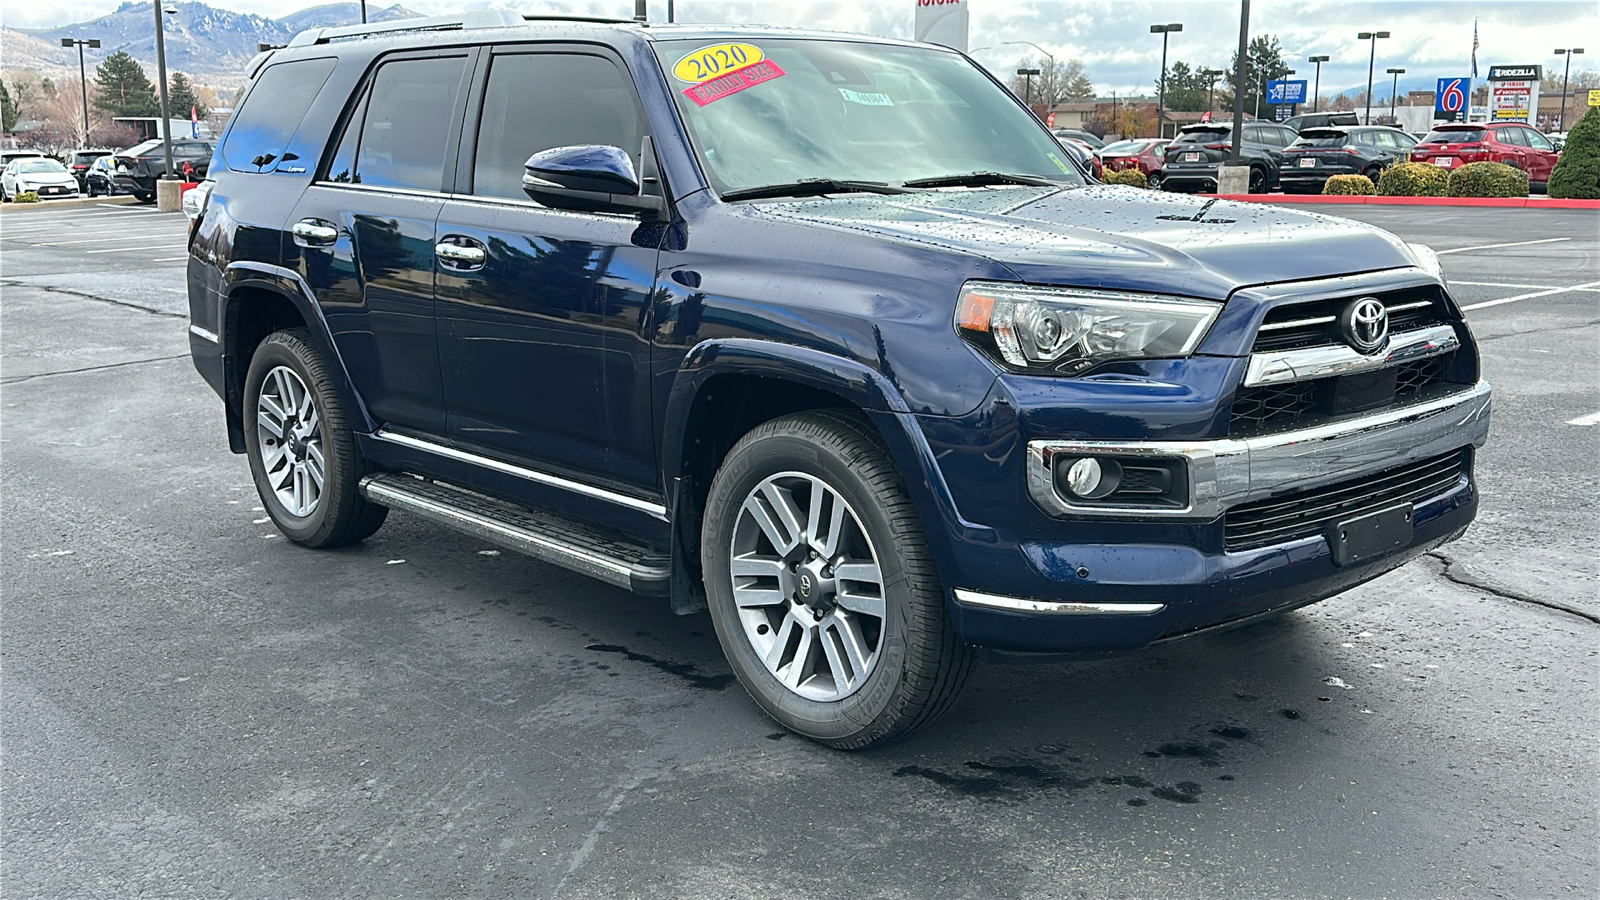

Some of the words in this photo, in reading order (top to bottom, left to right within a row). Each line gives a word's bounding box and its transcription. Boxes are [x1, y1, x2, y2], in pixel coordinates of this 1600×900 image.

[687, 45, 747, 79] 2020
[1501, 68, 1536, 77] RIDEZILLA
[692, 73, 746, 101] FAMILY
[742, 62, 776, 81] SIZE
[1441, 78, 1464, 111] 6
